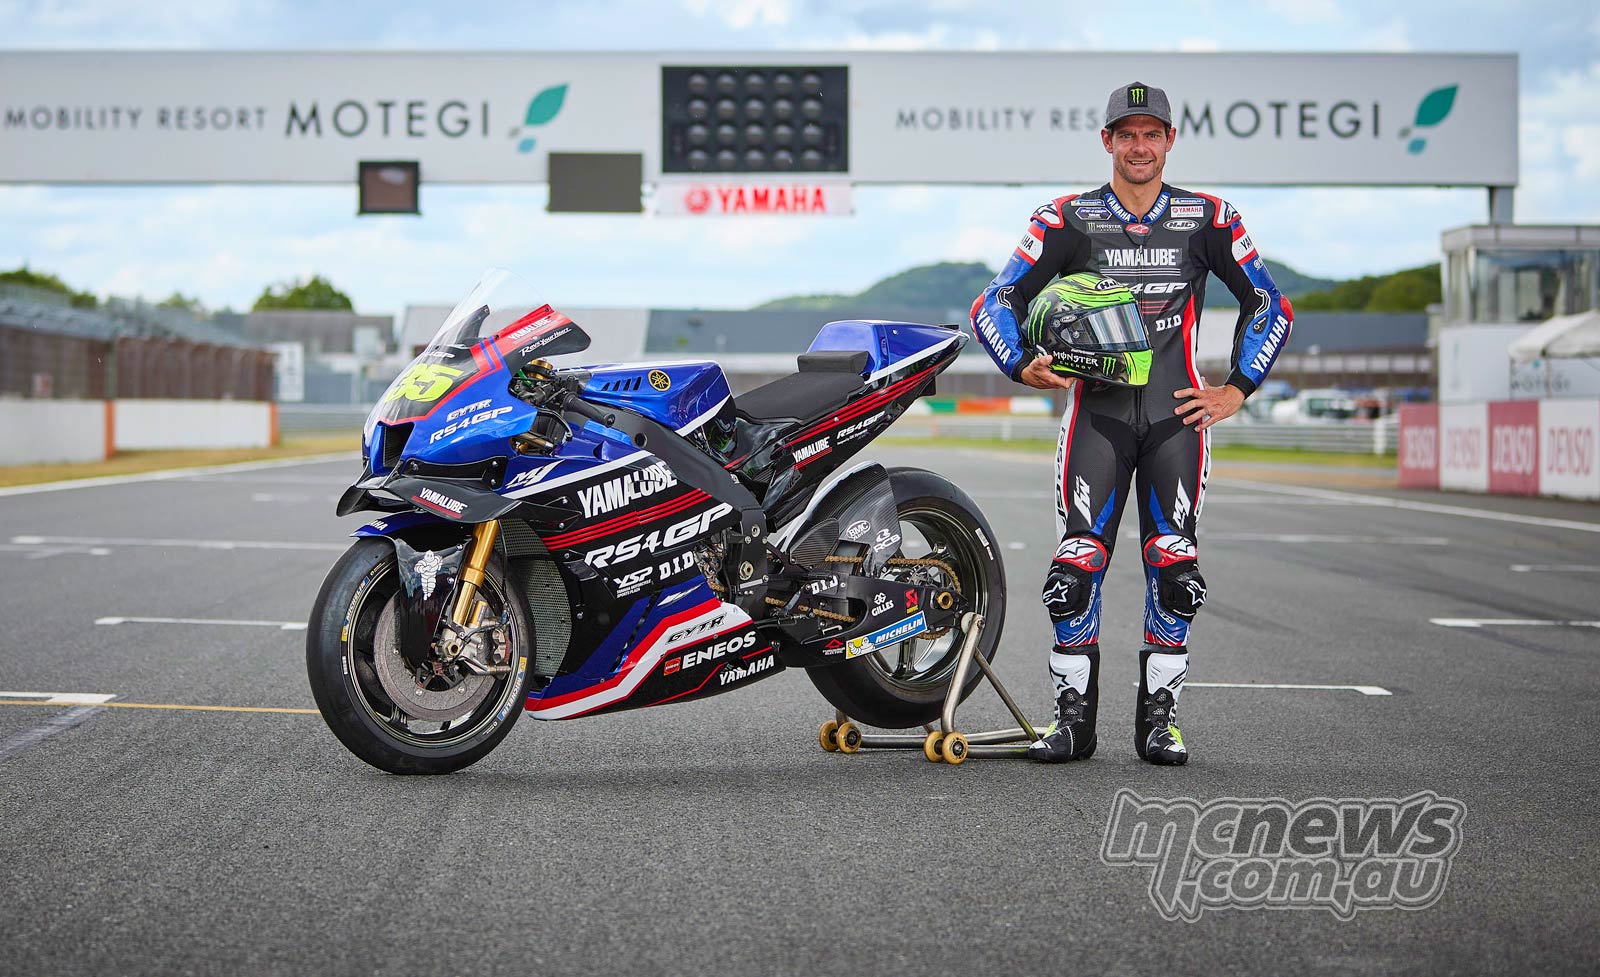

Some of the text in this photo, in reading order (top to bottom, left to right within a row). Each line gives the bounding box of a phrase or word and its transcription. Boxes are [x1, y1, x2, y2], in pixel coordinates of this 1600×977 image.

[4, 101, 491, 137] MOBILITY RESORT MOTEGI
[896, 101, 1381, 138] MOBILITY RES MOTEGI
[717, 186, 826, 213] YAMAHA
[1106, 195, 1131, 222] YAMAHA
[1148, 194, 1169, 221] YAMAHA
[1104, 248, 1179, 267] YAMALUBE
[975, 308, 1012, 365] YAMAHA
[1251, 314, 1289, 374] YAMAHA
[1053, 350, 1099, 367] MONSTER
[429, 405, 513, 445] RS4GP
[446, 398, 493, 423] GYTR
[836, 410, 886, 440] RS4GP
[792, 436, 830, 463] YAMALUBE
[1492, 425, 1536, 474] DENSO
[1548, 426, 1594, 476] DENSO
[419, 487, 468, 514] YAMALUBE
[577, 461, 678, 519] YAMALUBE
[584, 502, 734, 569] RS4GP
[849, 522, 869, 538] BMC
[613, 566, 653, 588] YSP
[871, 600, 895, 617] GILLES
[665, 612, 728, 645] GYTR
[875, 618, 923, 643] MICHELIN
[682, 630, 757, 670] ENEOS
[720, 655, 775, 686] YAMAHA
